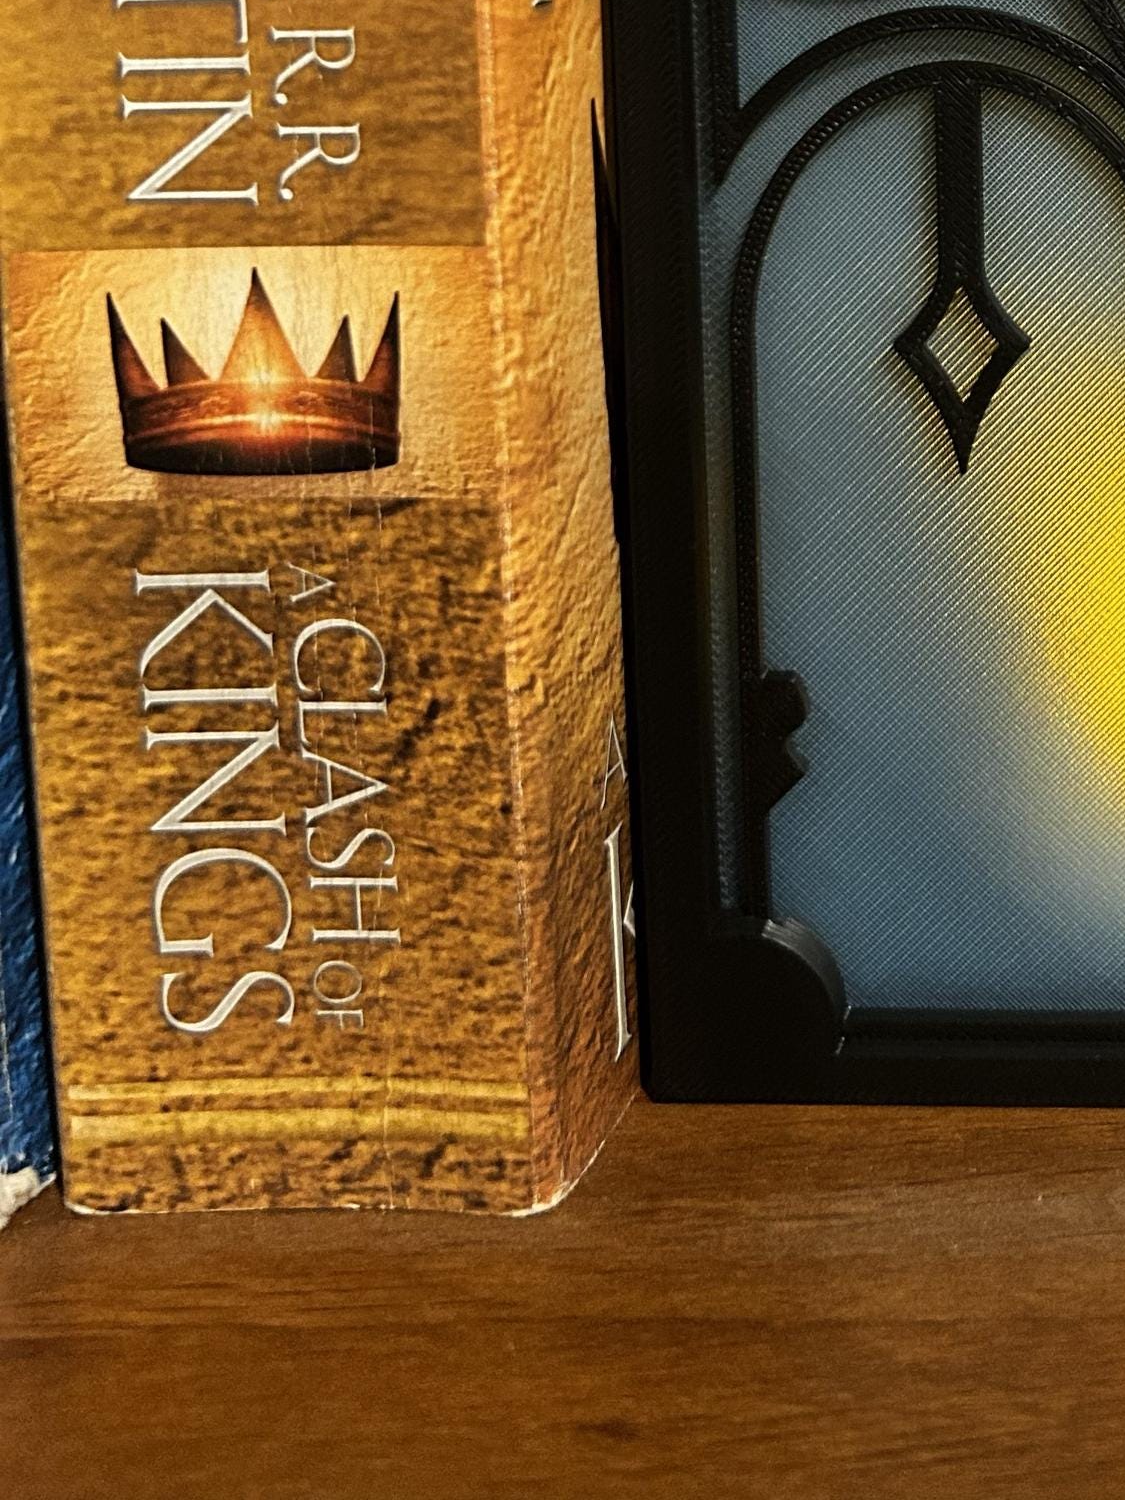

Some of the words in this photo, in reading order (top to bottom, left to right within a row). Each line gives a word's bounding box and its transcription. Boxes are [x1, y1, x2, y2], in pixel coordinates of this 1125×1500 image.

[269, 25, 357, 107] R.
[275, 122, 362, 202] R.
[286, 560, 337, 603] A
[133, 567, 296, 1035] KINGS
[292, 617, 402, 945] CLASH
[311, 959, 365, 1033] OF
